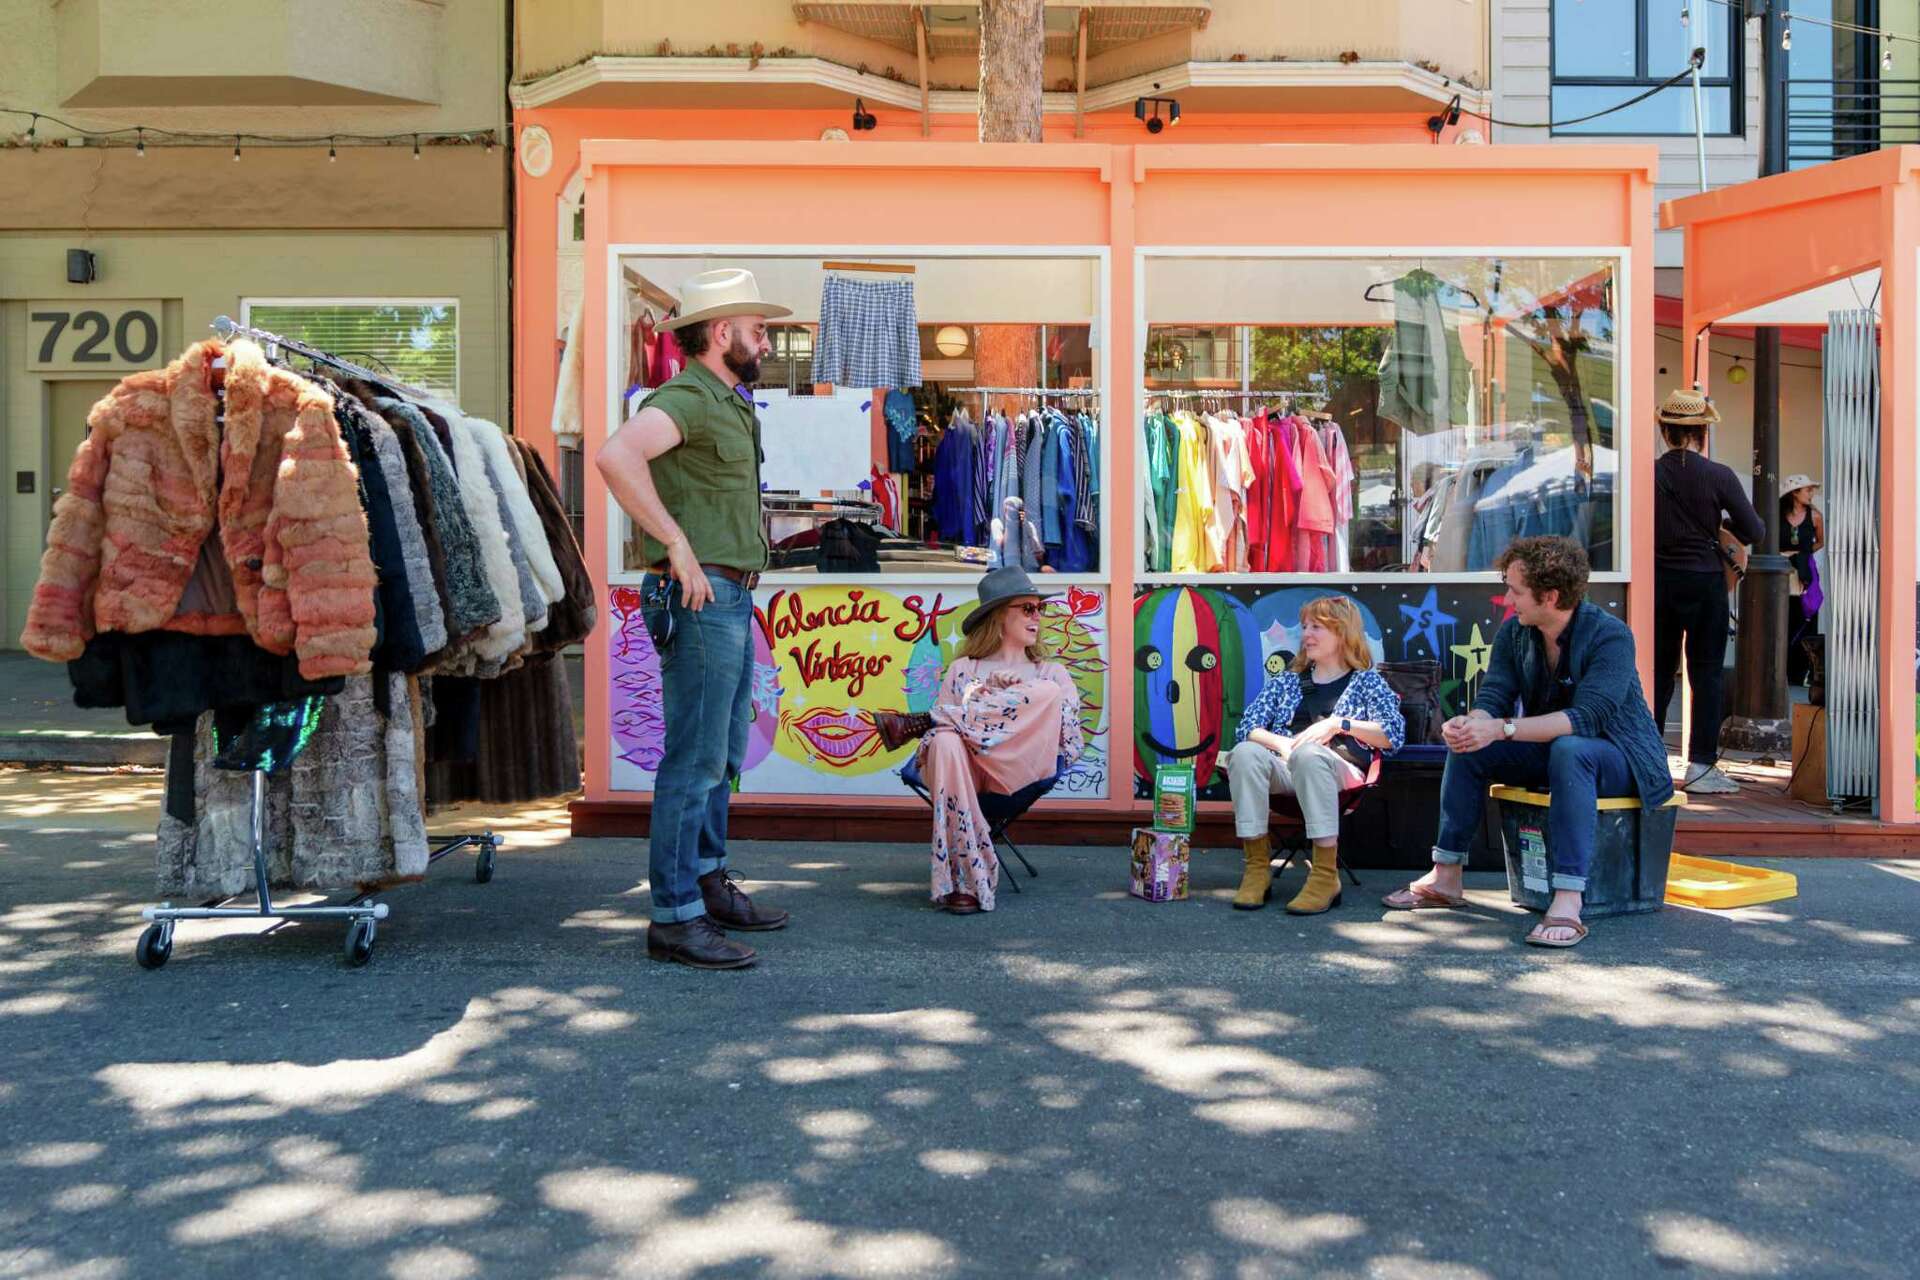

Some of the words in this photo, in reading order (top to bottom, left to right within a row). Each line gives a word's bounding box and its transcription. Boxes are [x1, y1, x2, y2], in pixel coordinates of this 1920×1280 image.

[31, 310, 158, 363] 720
[754, 589, 890, 649] Valencia
[894, 593, 957, 646] St
